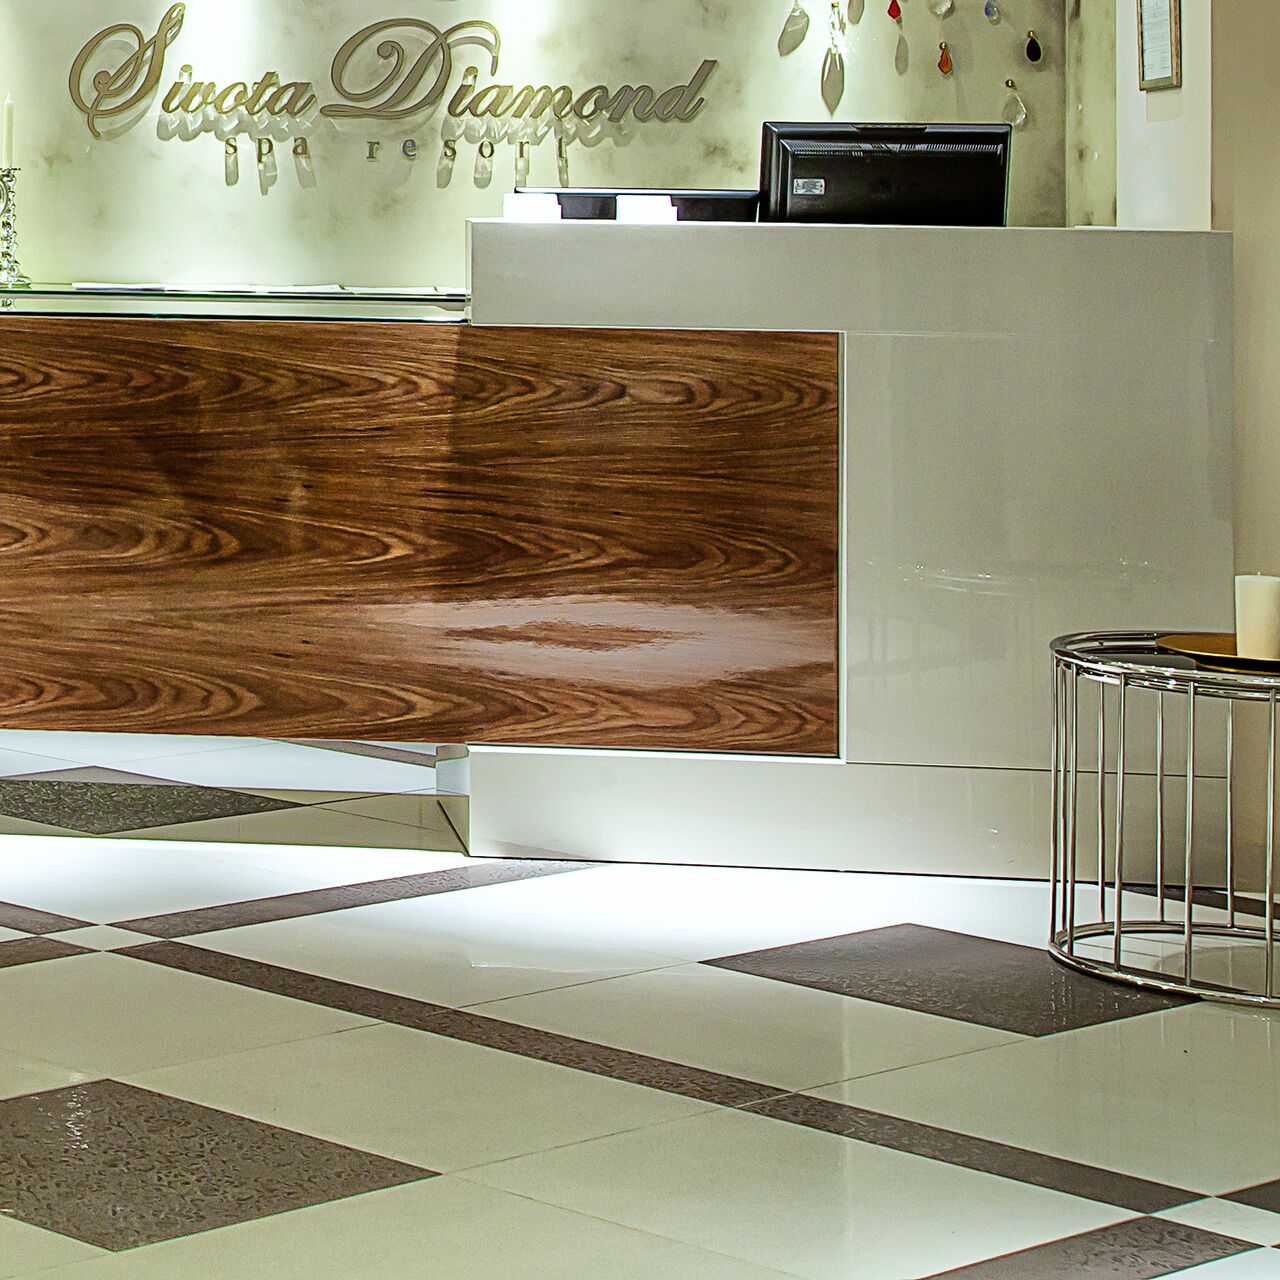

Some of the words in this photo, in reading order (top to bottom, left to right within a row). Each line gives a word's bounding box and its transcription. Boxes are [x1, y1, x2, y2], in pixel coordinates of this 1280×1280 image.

[68, 1, 318, 139] Sivota
[319, 17, 719, 123] Diamond
[224, 136, 309, 164] spa
[365, 137, 567, 160] resort
